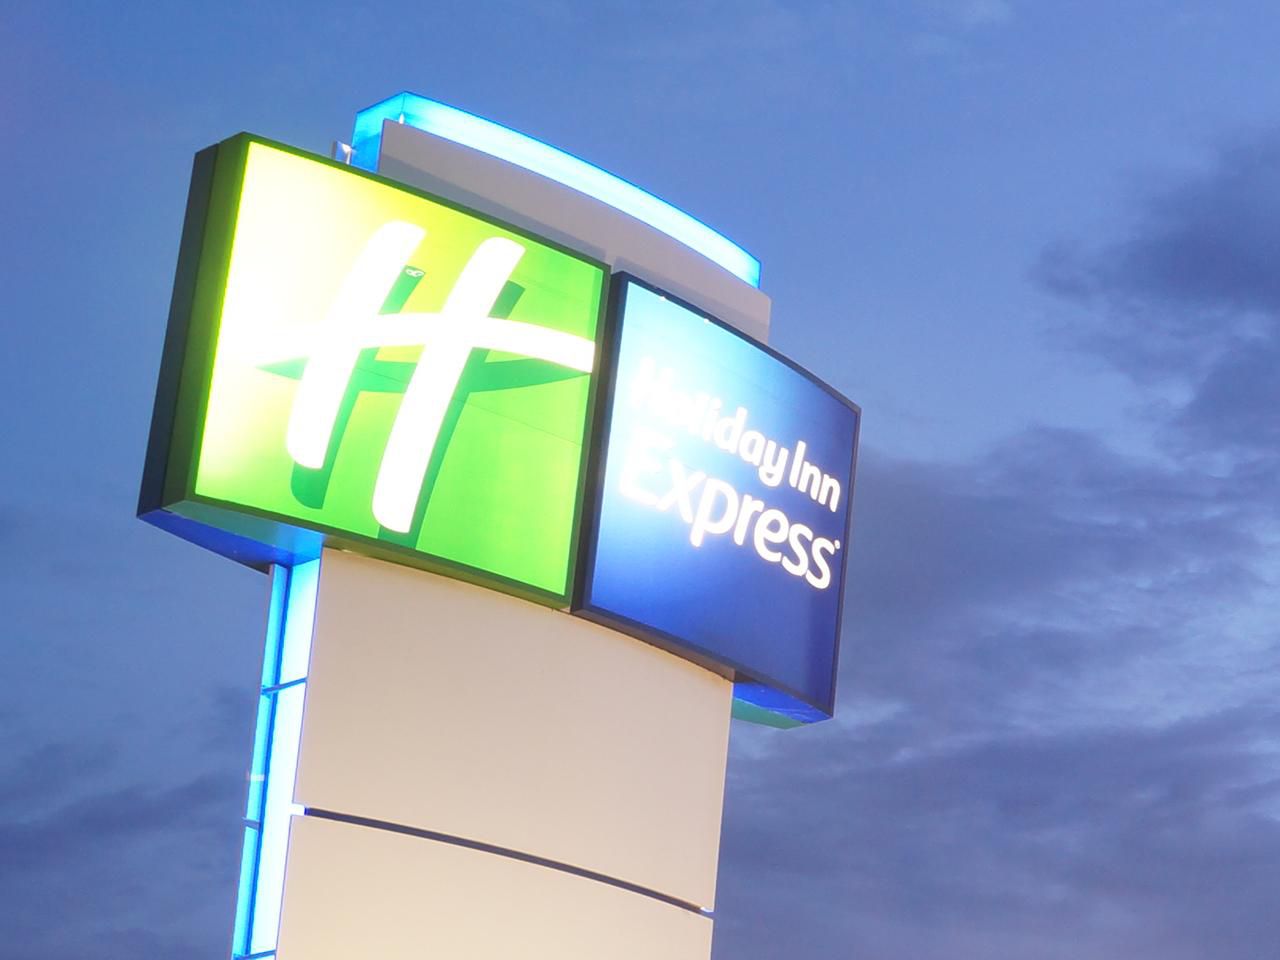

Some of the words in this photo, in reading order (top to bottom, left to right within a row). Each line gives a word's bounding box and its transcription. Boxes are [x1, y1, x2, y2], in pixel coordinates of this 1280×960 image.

[619, 420, 836, 589] Express
[631, 357, 788, 487] Holiday
[789, 440, 841, 512] Inn
